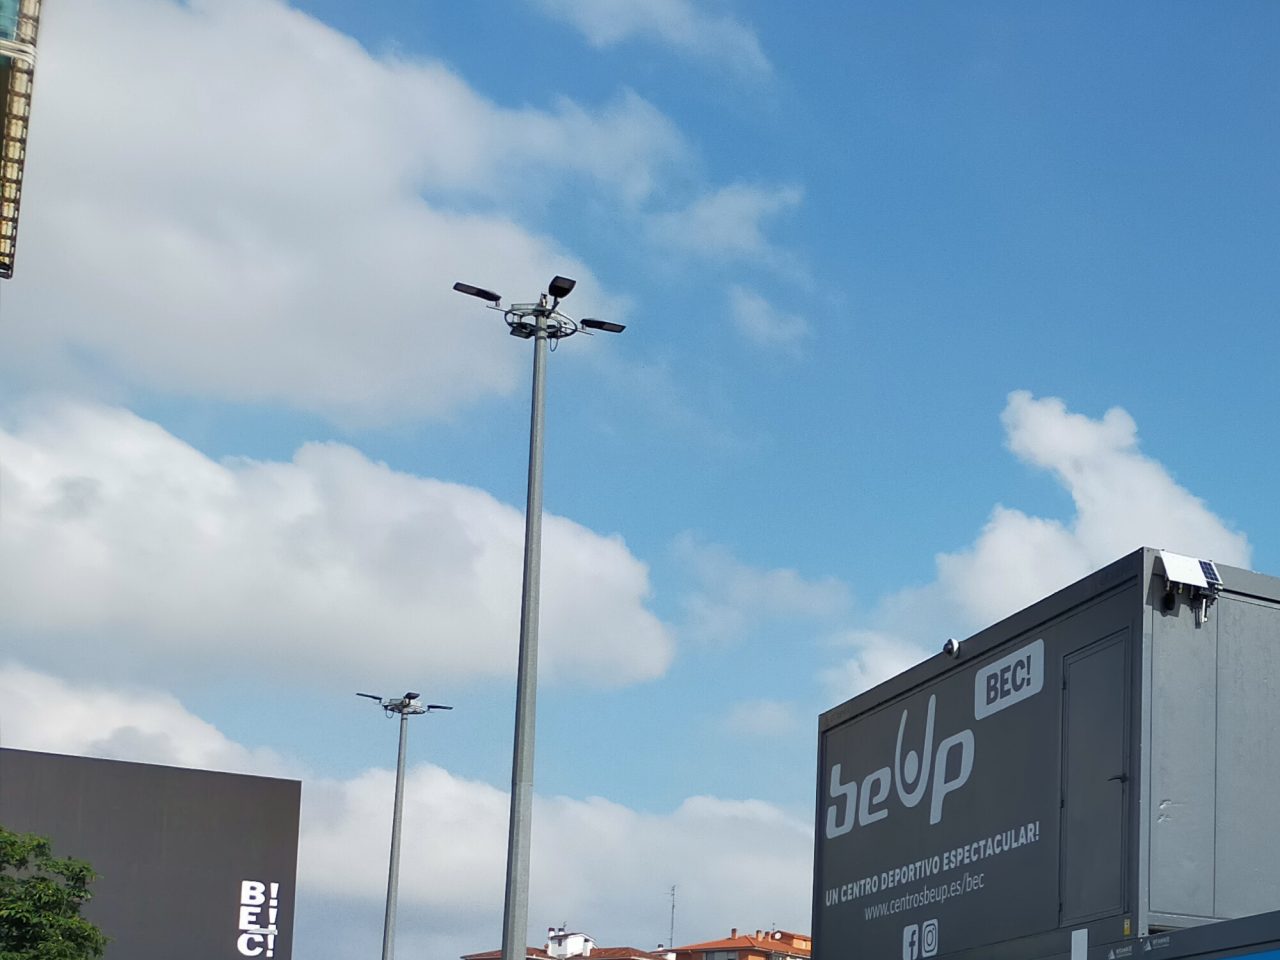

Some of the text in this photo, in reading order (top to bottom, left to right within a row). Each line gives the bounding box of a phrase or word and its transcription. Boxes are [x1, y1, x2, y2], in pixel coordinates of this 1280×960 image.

[986, 655, 1032, 706] BEC!
[825, 821, 1040, 906] UN CENTRO DEPORTIVO ESPECTACULAR!
[864, 872, 985, 920] www.centrosbeup.es/bec
